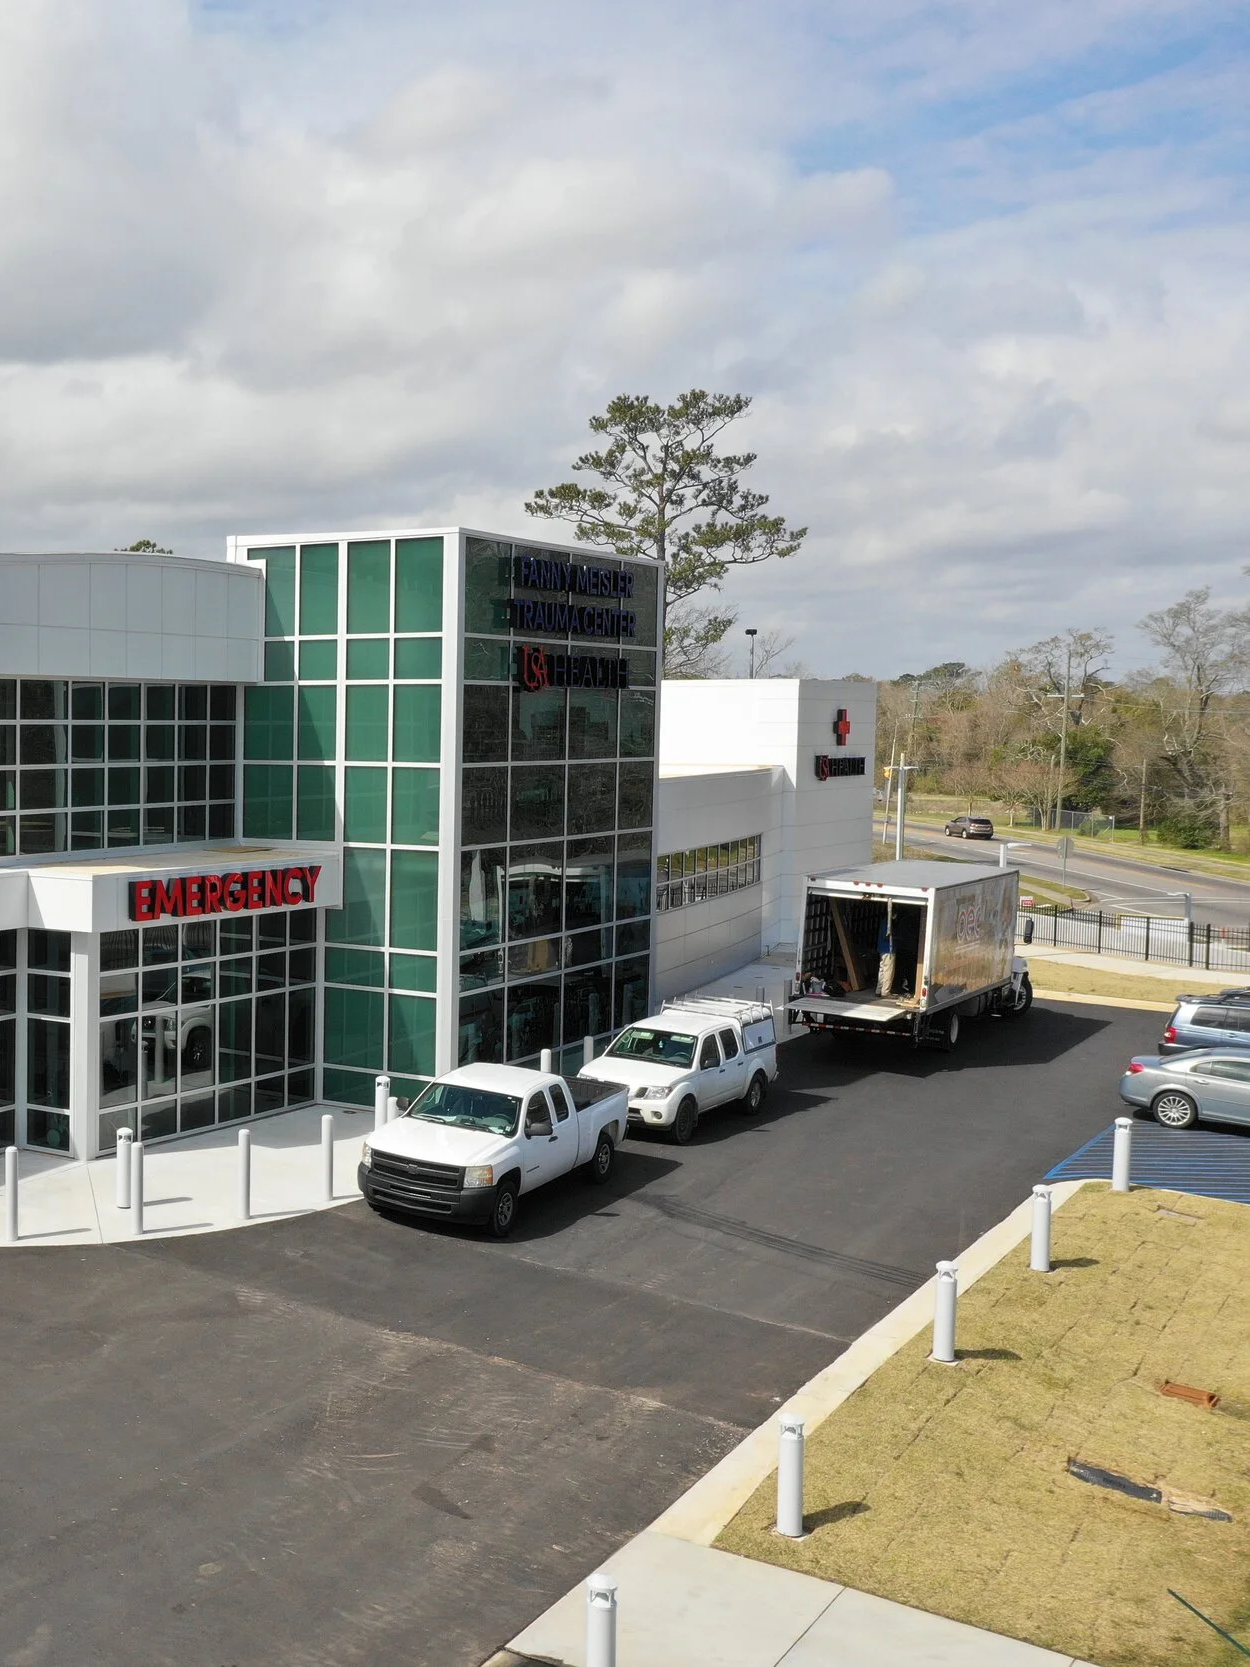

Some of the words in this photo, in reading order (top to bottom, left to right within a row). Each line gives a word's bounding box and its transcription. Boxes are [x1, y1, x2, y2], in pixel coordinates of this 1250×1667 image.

[520, 555, 572, 589] FANNY
[576, 565, 635, 598] MEISLER
[514, 599, 581, 632] TRAUMA
[583, 607, 637, 637] CENTER
[553, 655, 630, 689] HEALTH
[130, 865, 322, 921] EMERGENCY
